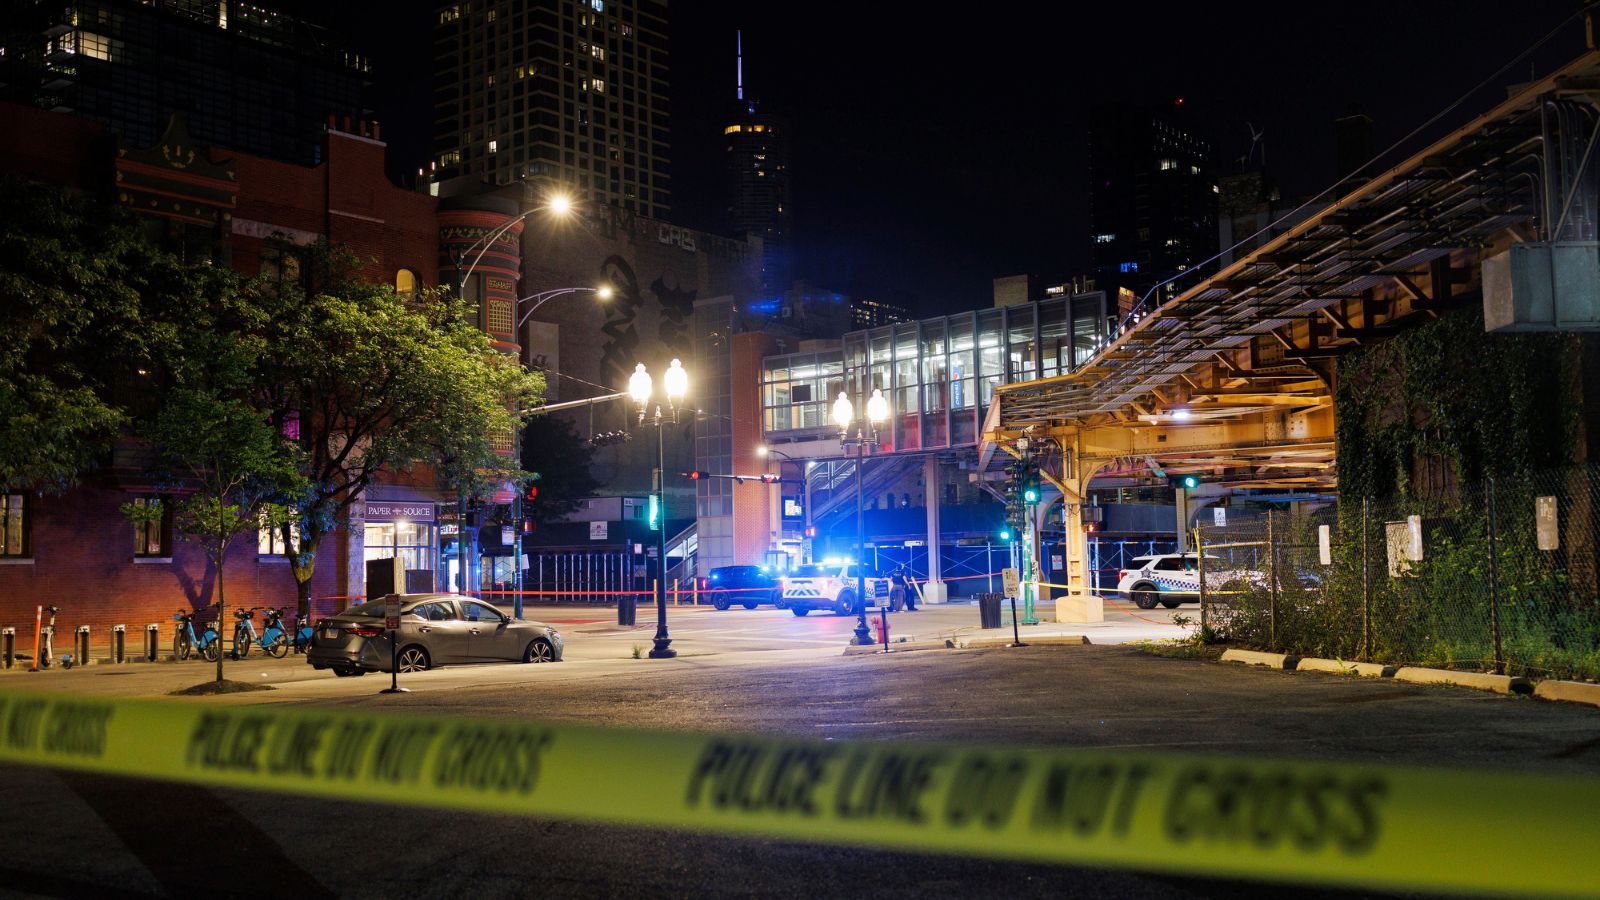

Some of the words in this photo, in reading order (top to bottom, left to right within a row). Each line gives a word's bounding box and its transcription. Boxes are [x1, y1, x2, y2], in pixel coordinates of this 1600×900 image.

[368, 506, 391, 515] PAPER
[403, 507, 430, 516] SOURCE
[43, 702, 115, 758] CROSS
[186, 711, 274, 773] POLICE
[269, 715, 336, 779] LINE
[325, 718, 378, 783] DO
[374, 722, 441, 788] NOT
[433, 725, 553, 796] CROSS
[686, 740, 838, 817] POLICE
[834, 748, 945, 826] LINE
[945, 755, 1030, 832] DO
[1030, 762, 1155, 840] NOT
[1164, 764, 1389, 858] CROSS
